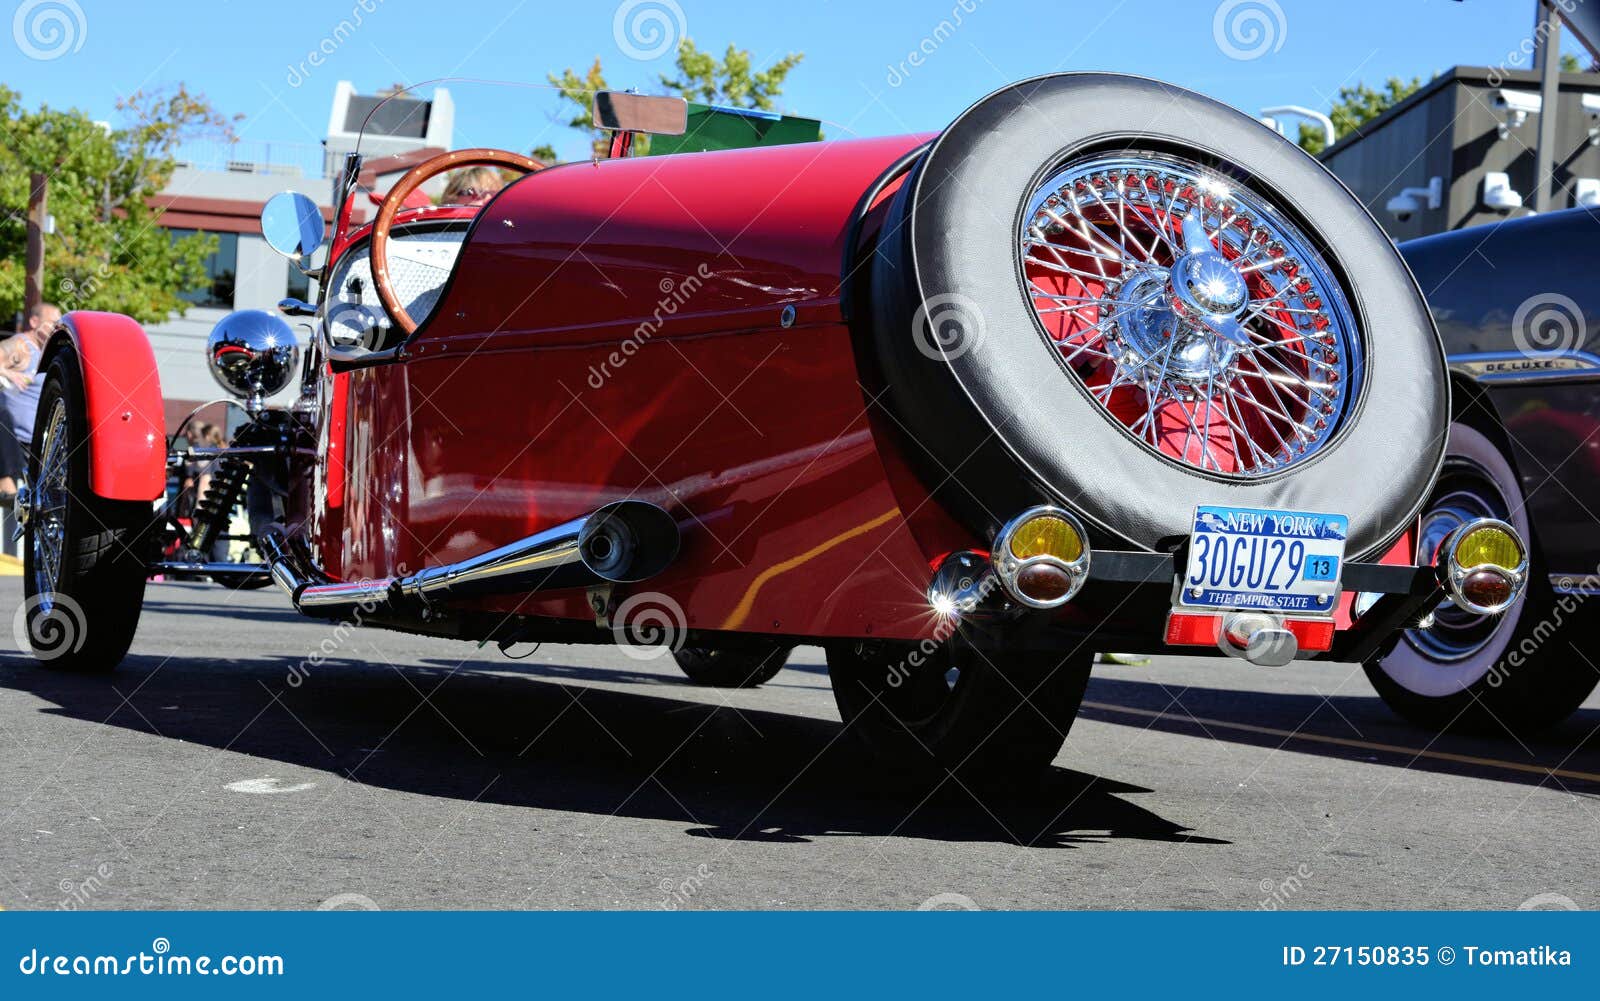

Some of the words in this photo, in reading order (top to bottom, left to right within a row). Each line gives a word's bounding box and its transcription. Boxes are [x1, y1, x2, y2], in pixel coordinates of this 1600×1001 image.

[1486, 363, 1505, 371] DE
[1511, 360, 1553, 370] LUXE
[1224, 511, 1267, 534] NEW
[1272, 514, 1319, 537] YORK
[1190, 534, 1305, 591] 30GU29
[1312, 560, 1330, 576] 13
[1208, 592, 1232, 605] THE
[1235, 593, 1275, 607] EMPIRE
[1277, 596, 1309, 608] STATE
